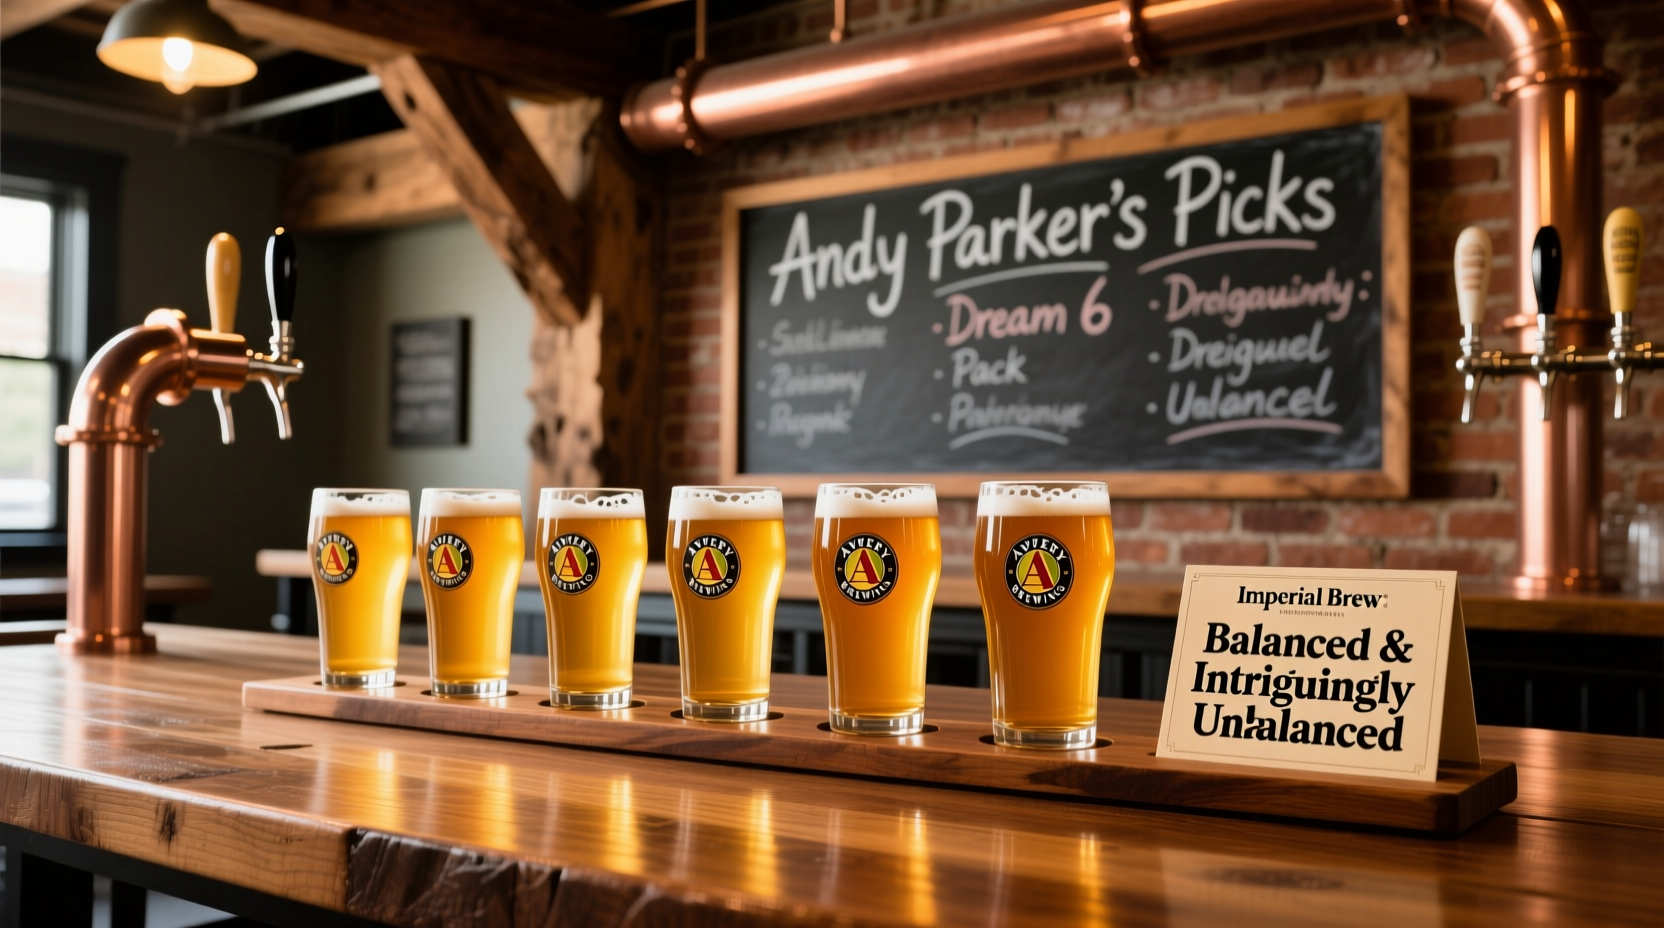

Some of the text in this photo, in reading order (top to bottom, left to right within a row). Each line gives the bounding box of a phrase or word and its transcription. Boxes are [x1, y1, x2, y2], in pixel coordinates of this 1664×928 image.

[769, 151, 1335, 316] Andy Parker's Picks
[944, 293, 1068, 346] Dream
[1079, 275, 1113, 336] 6
[952, 345, 1029, 389] Pack
[1237, 586, 1322, 611] Imperial
[1203, 622, 1414, 663] Balanced &
[1190, 661, 1415, 715] Intriguingly
